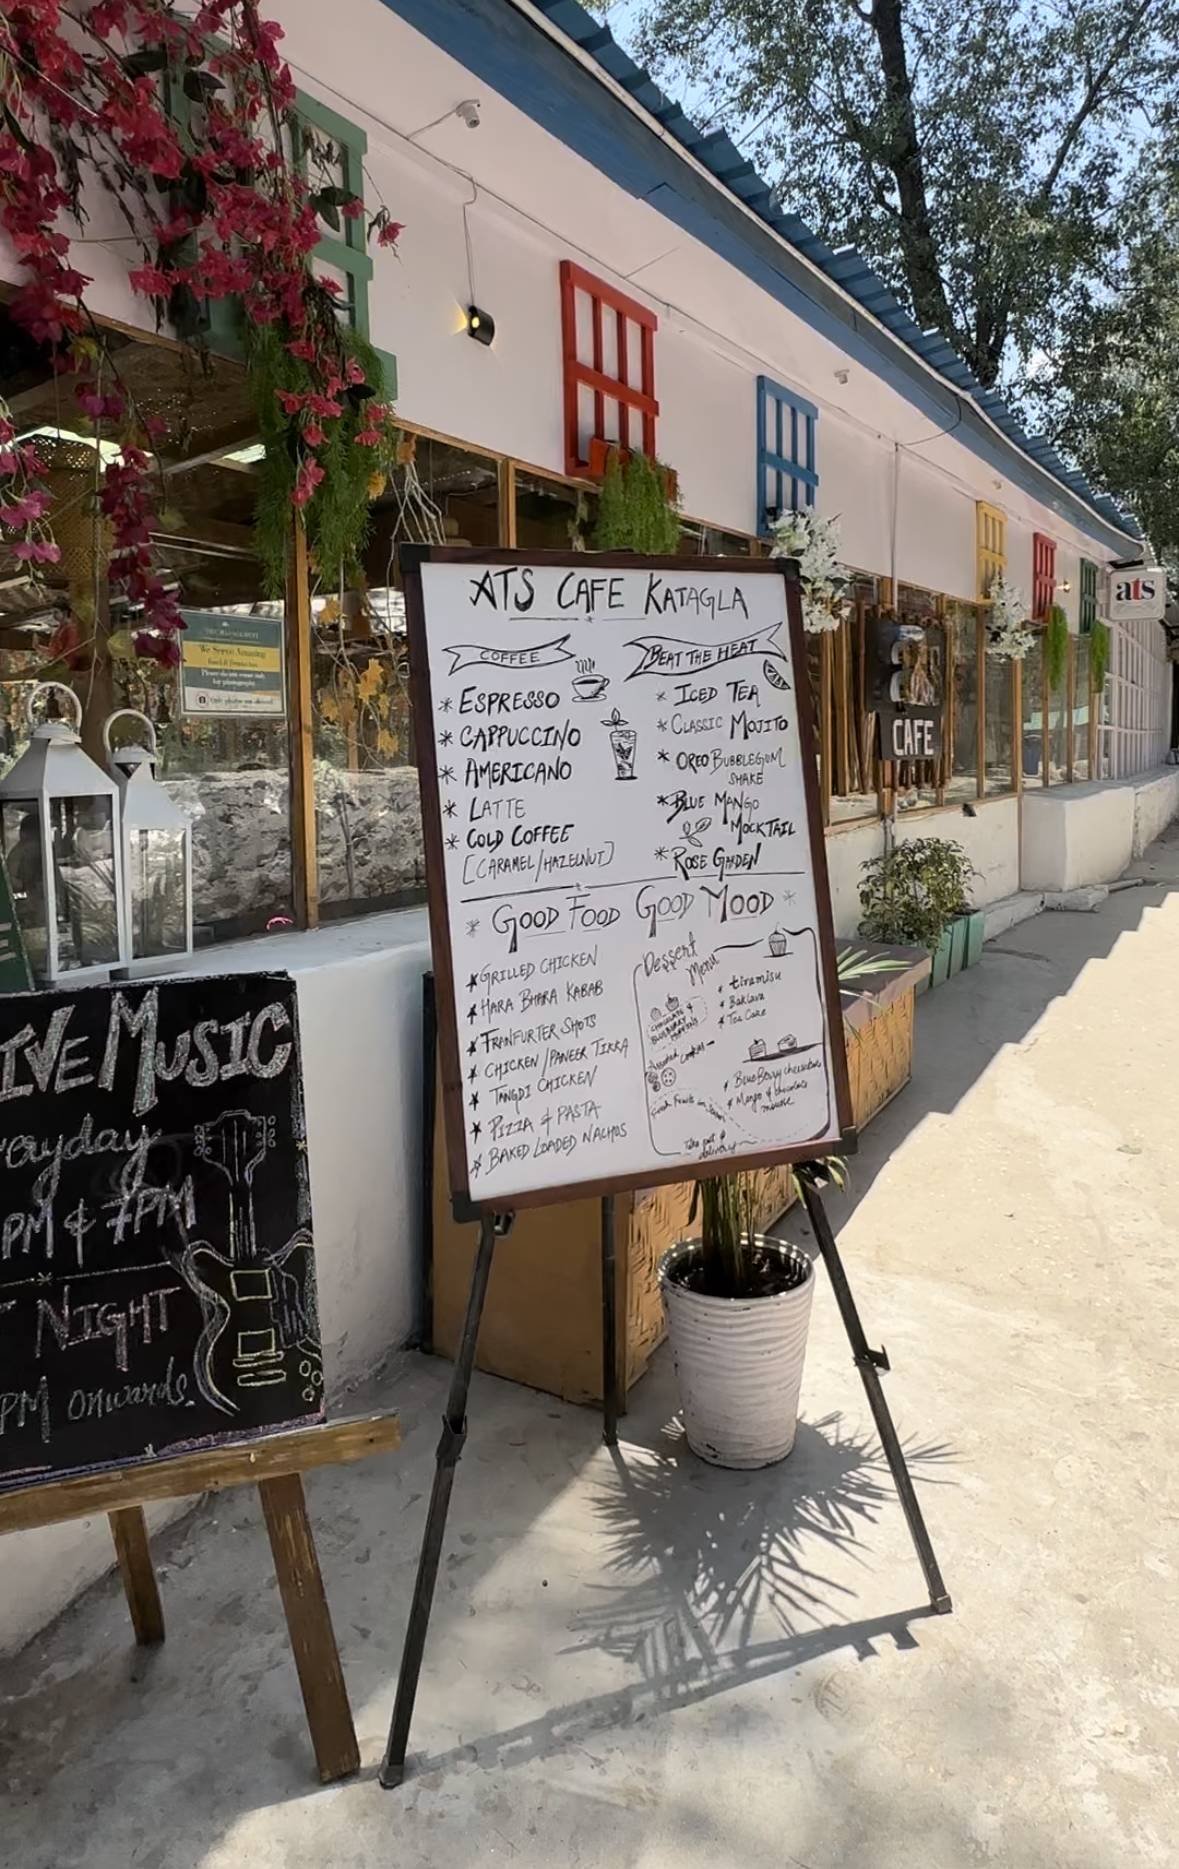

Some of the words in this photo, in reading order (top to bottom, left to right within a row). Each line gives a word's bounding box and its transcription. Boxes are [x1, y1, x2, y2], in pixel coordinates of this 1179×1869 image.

[469, 567, 534, 612] ATS
[557, 572, 625, 613] CAFE
[645, 572, 749, 620] KATAGLA
[1116, 578, 1155, 601] ats
[480, 651, 541, 664] COFFEE
[644, 645, 683, 670] BEAT
[686, 649, 712, 665] THE
[717, 639, 759, 662] HEAT
[459, 686, 561, 716] ESPRESSO
[674, 683, 718, 706] ICED
[726, 680, 761, 708] TEA
[459, 719, 582, 752] CAPPUCCINO
[671, 713, 723, 734] CLASSIC
[730, 710, 788, 740] MOJITO
[892, 719, 934, 756] CAFE
[465, 756, 572, 789] AMERICANO
[676, 752, 709, 774] OREO
[710, 748, 786, 775] BUBBLEGUM
[728, 772, 764, 785] SHAKE
[469, 797, 526, 822] LATTE
[667, 790, 705, 824] BLUE
[714, 790, 760, 825] MANGO
[466, 828, 504, 853] COLD
[511, 824, 575, 847] COFFEE
[730, 813, 797, 845] MOCKTAIL
[671, 846, 708, 881] ROSE
[492, 903, 559, 952] GOOD
[565, 893, 620, 930] FOOD
[636, 885, 694, 938] GOOD
[699, 884, 774, 923] MOOD
[480, 963, 536, 995] GRILLED
[540, 944, 598, 974] CHICKEN
[480, 998, 514, 1024] HARA
[566, 980, 604, 1002] KABAB
[560, 1014, 596, 1038] SHOTS
[98, 986, 293, 1117] MUSIC
[590, 1038, 630, 1059] TIKKA
[489, 1084, 531, 1114] TANGDI
[537, 1065, 598, 1093] CHICKEN
[488, 1114, 534, 1141] PIZZA
[557, 1099, 602, 1125] PASTA
[485, 1144, 530, 1175] BAKED
[533, 1137, 577, 1158] LOADED
[582, 1123, 629, 1143] NACHOS
[63, 1198, 97, 1268] &
[36, 1284, 181, 1372] NIGHT
